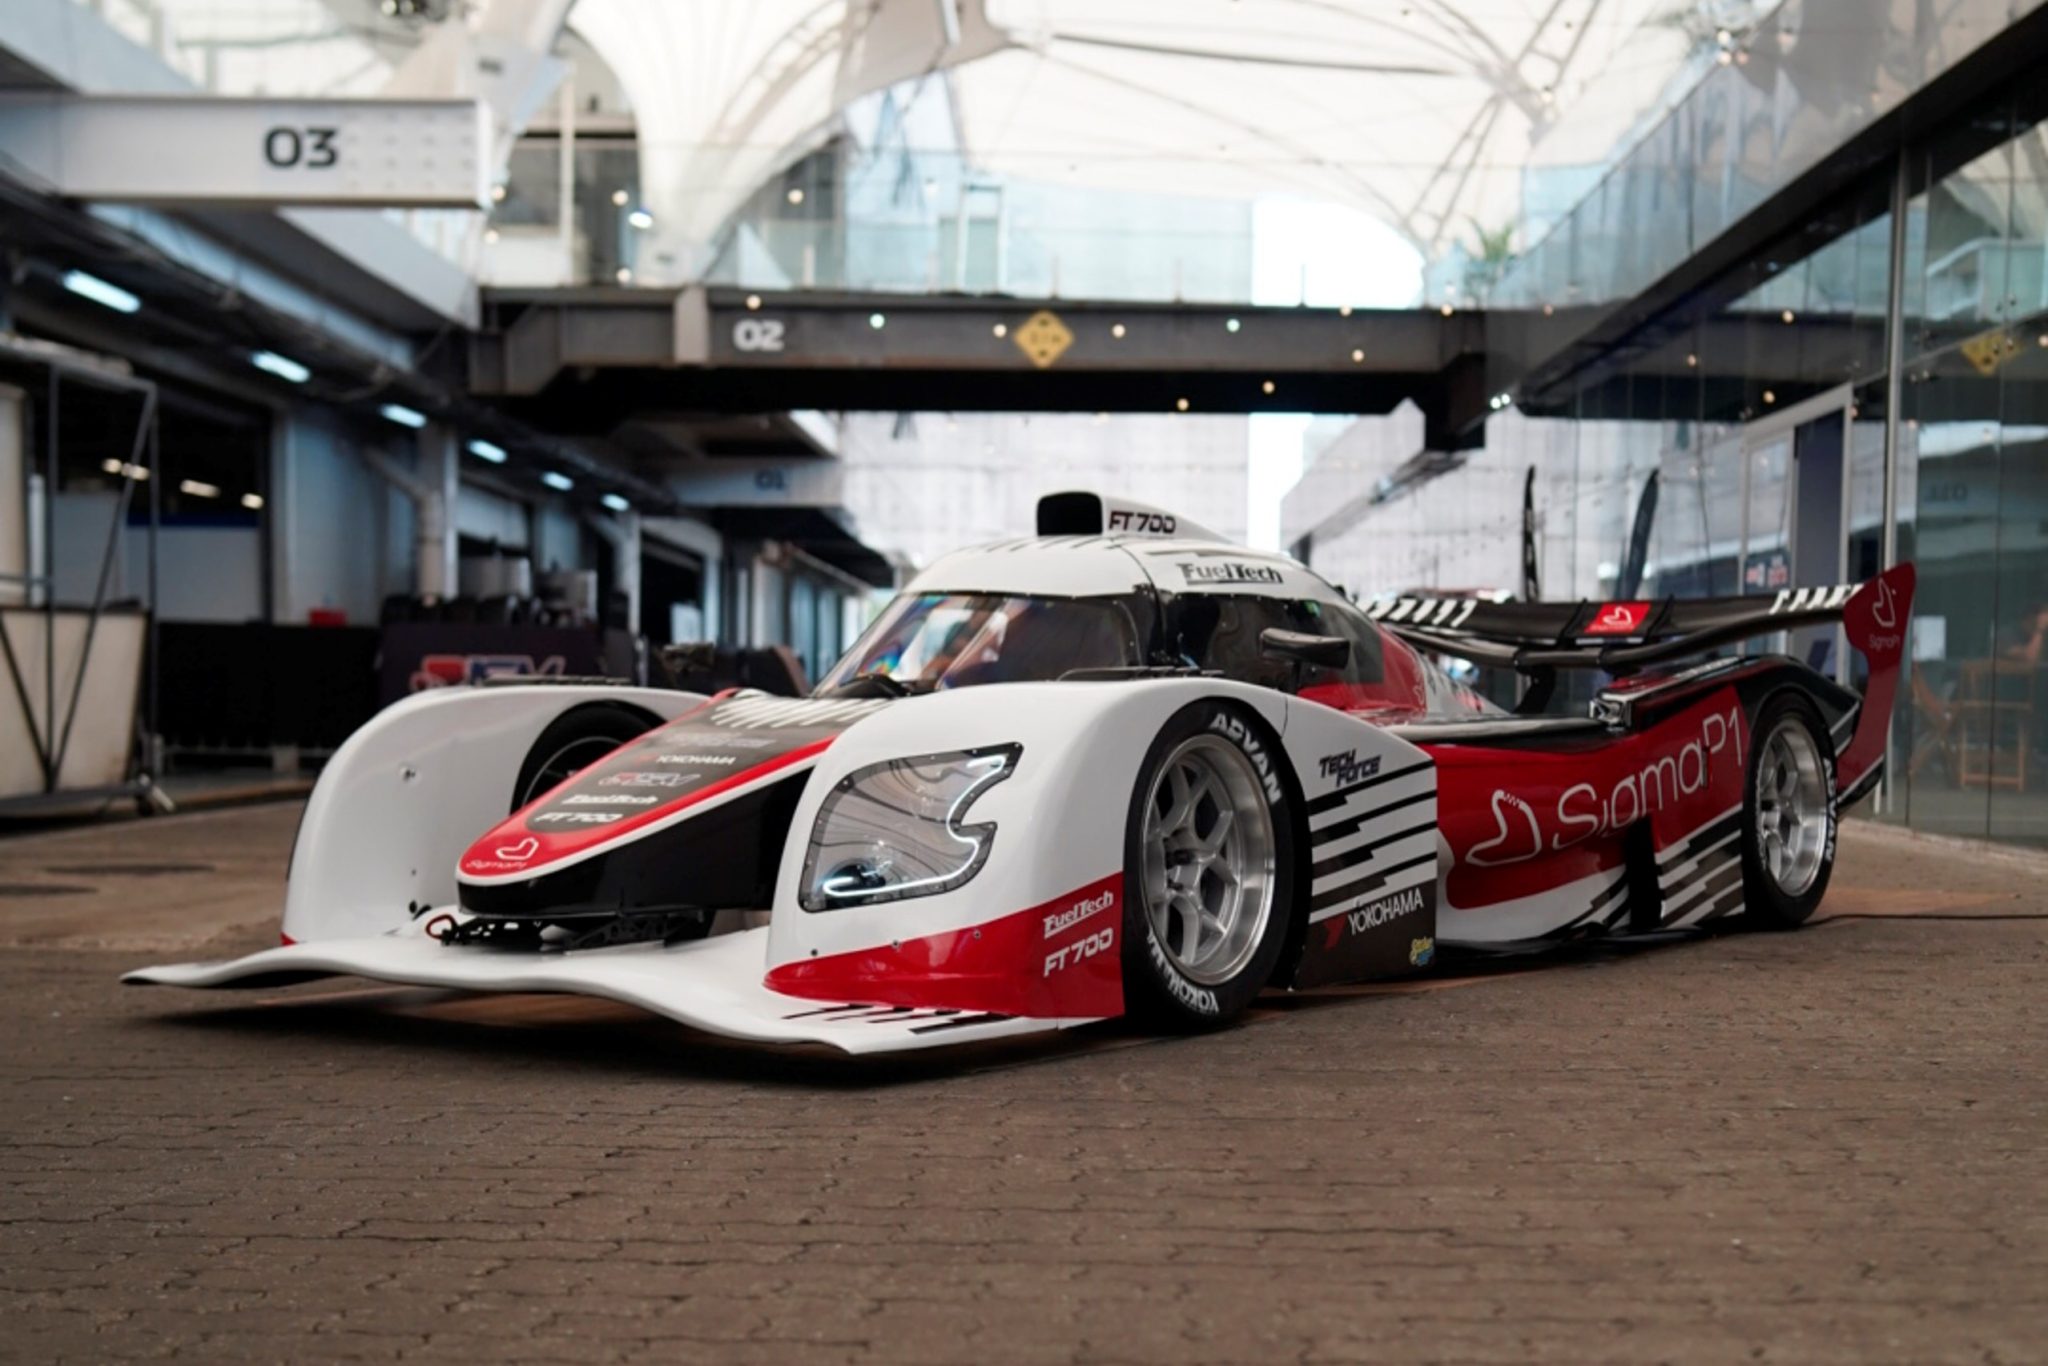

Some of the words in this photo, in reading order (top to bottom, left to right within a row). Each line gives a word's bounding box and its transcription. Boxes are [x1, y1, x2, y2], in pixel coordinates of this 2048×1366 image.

[264, 126, 339, 169] 03
[733, 319, 785, 351] 02
[1176, 563, 1284, 586] FuelTech
[1208, 712, 1283, 805] ADVAN
[1042, 889, 1114, 940] FuelTech
[1347, 887, 1424, 936] YOKOHAMA
